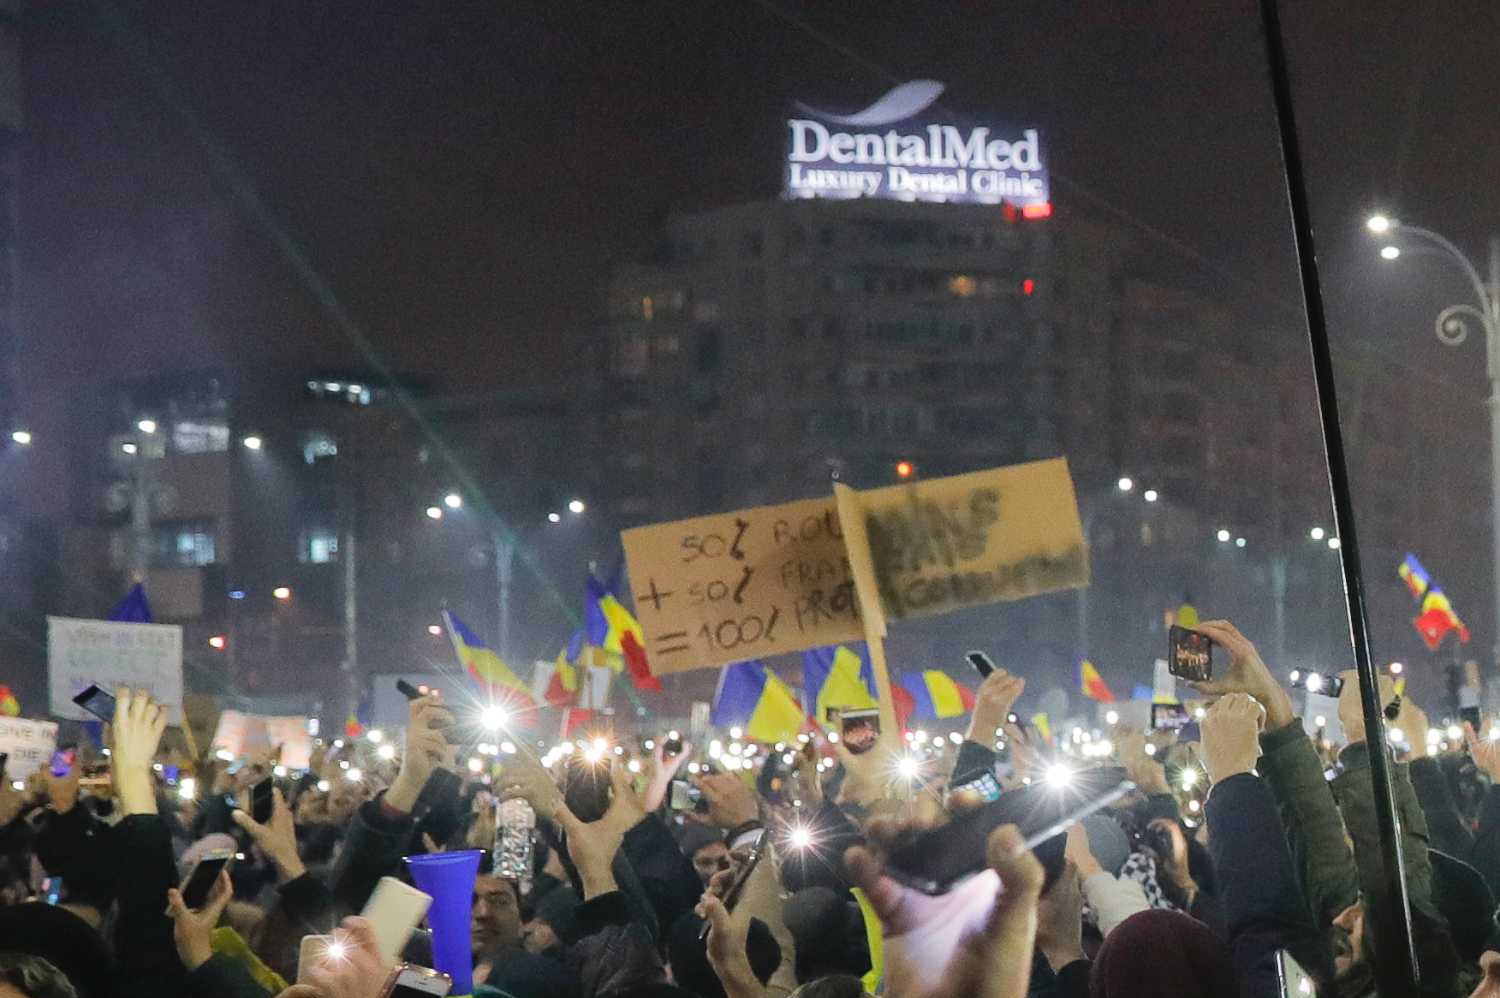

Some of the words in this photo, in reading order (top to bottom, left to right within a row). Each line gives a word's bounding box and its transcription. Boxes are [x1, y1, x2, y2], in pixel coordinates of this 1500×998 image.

[788, 119, 1042, 171] DentalMed
[789, 163, 882, 195] Luxury
[887, 167, 967, 194] Dental
[971, 170, 1044, 197] Clinic
